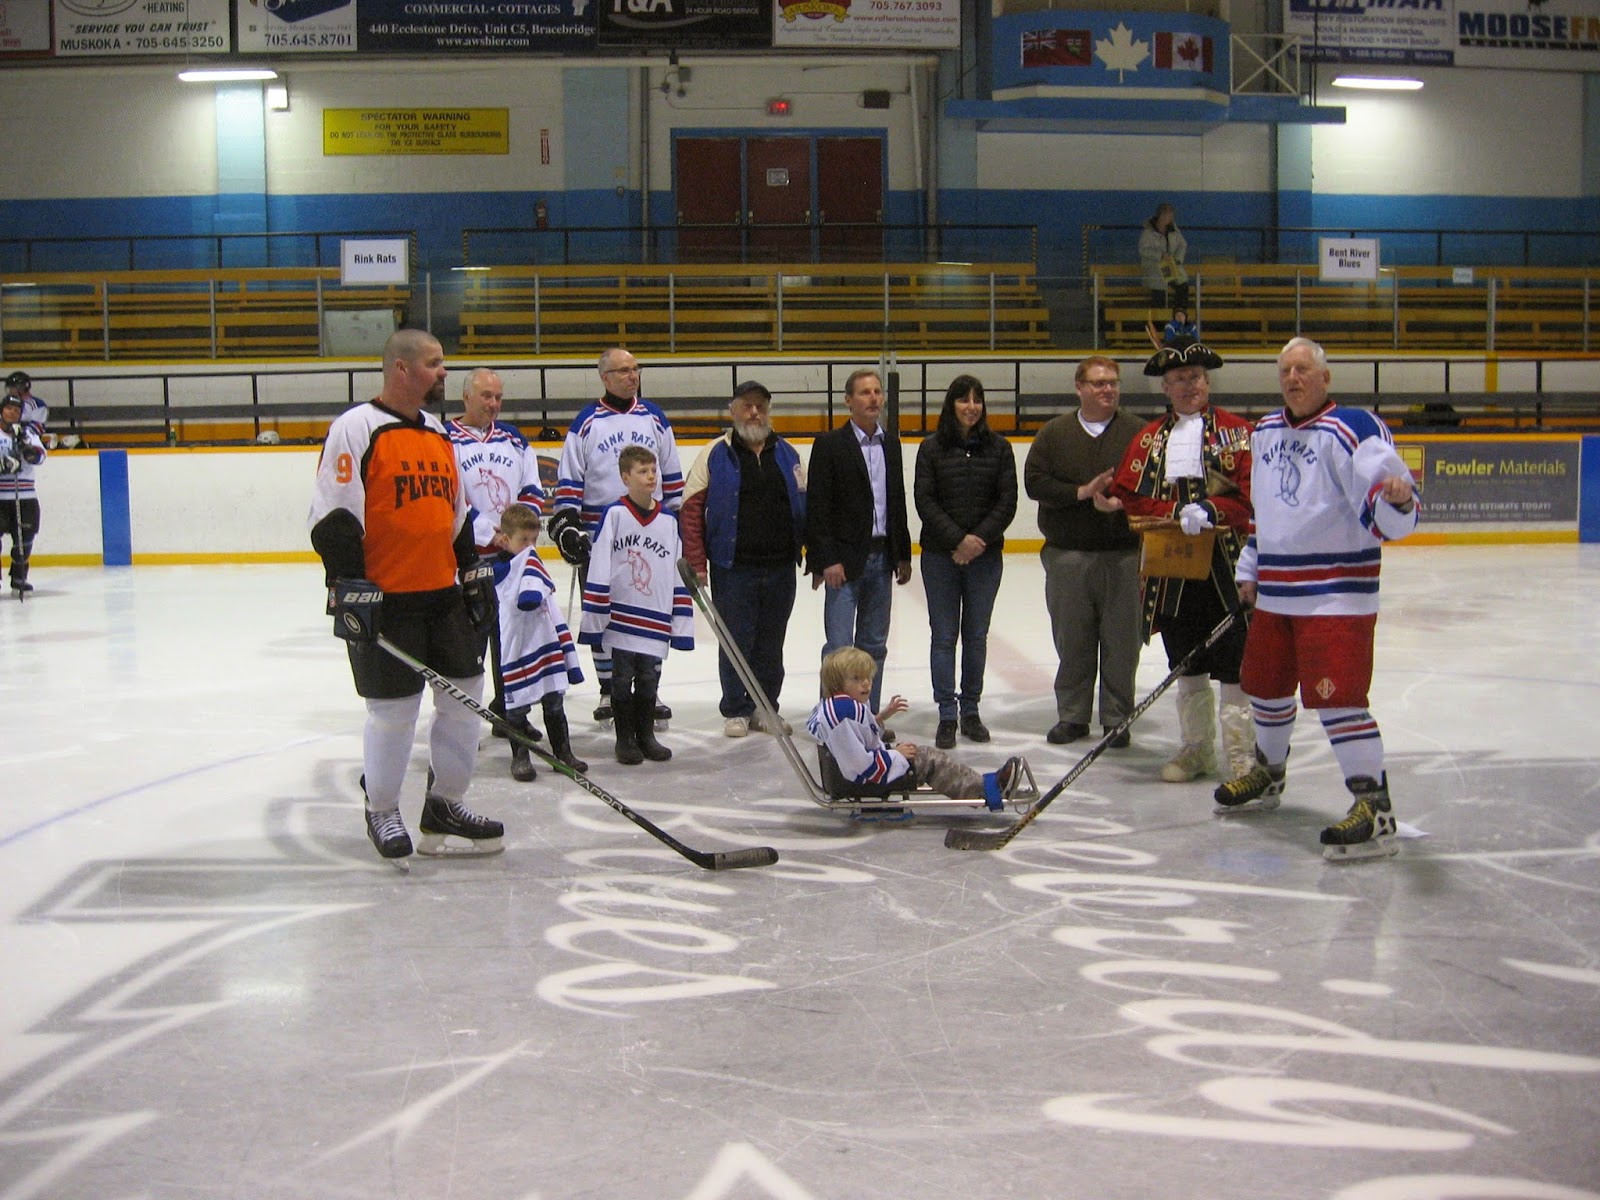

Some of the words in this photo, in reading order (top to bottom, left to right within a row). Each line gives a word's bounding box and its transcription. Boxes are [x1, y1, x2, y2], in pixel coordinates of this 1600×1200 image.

[147, 2, 185, 13] HEATING
[404, 4, 489, 15] COMMERCIAL
[498, 4, 561, 15] COTTAGES
[870, 1, 942, 11] 705.767.3093
[125, 24, 145, 33] YOU
[150, 23, 171, 32] CAN
[369, 25, 388, 34] 440
[391, 24, 447, 34] Ecclestone
[450, 24, 482, 35] Drive,
[485, 24, 508, 34] Unit
[510, 24, 529, 35] C5,
[532, 24, 596, 36] Bracebridge
[60, 39, 121, 50] MUSKOKA
[136, 36, 224, 48] 705-645-3250
[264, 33, 352, 46] 705.645.8701
[361, 112, 417, 121] SPECTATOR
[423, 112, 471, 121] WARNING
[1329, 247, 1348, 258] Bent
[1350, 247, 1370, 258] River
[354, 254, 374, 264] Rink
[376, 254, 397, 264] Rats
[1338, 258, 1361, 268] Blues
[599, 431, 625, 453] RINK
[631, 432, 656, 449] RATS
[1262, 439, 1286, 465] RINK
[1290, 440, 1317, 465] RATS
[461, 452, 484, 472] RINK
[489, 453, 514, 468] RATS
[1435, 459, 1495, 476] Fowler
[1500, 459, 1566, 476] Materials
[336, 453, 353, 484] 9
[1431, 503, 1447, 511] FOR
[1480, 502, 1518, 511] ESTIMATE
[613, 534, 640, 552] RINK
[643, 535, 670, 559] RATS
[573, 769, 624, 814] VAPOR
